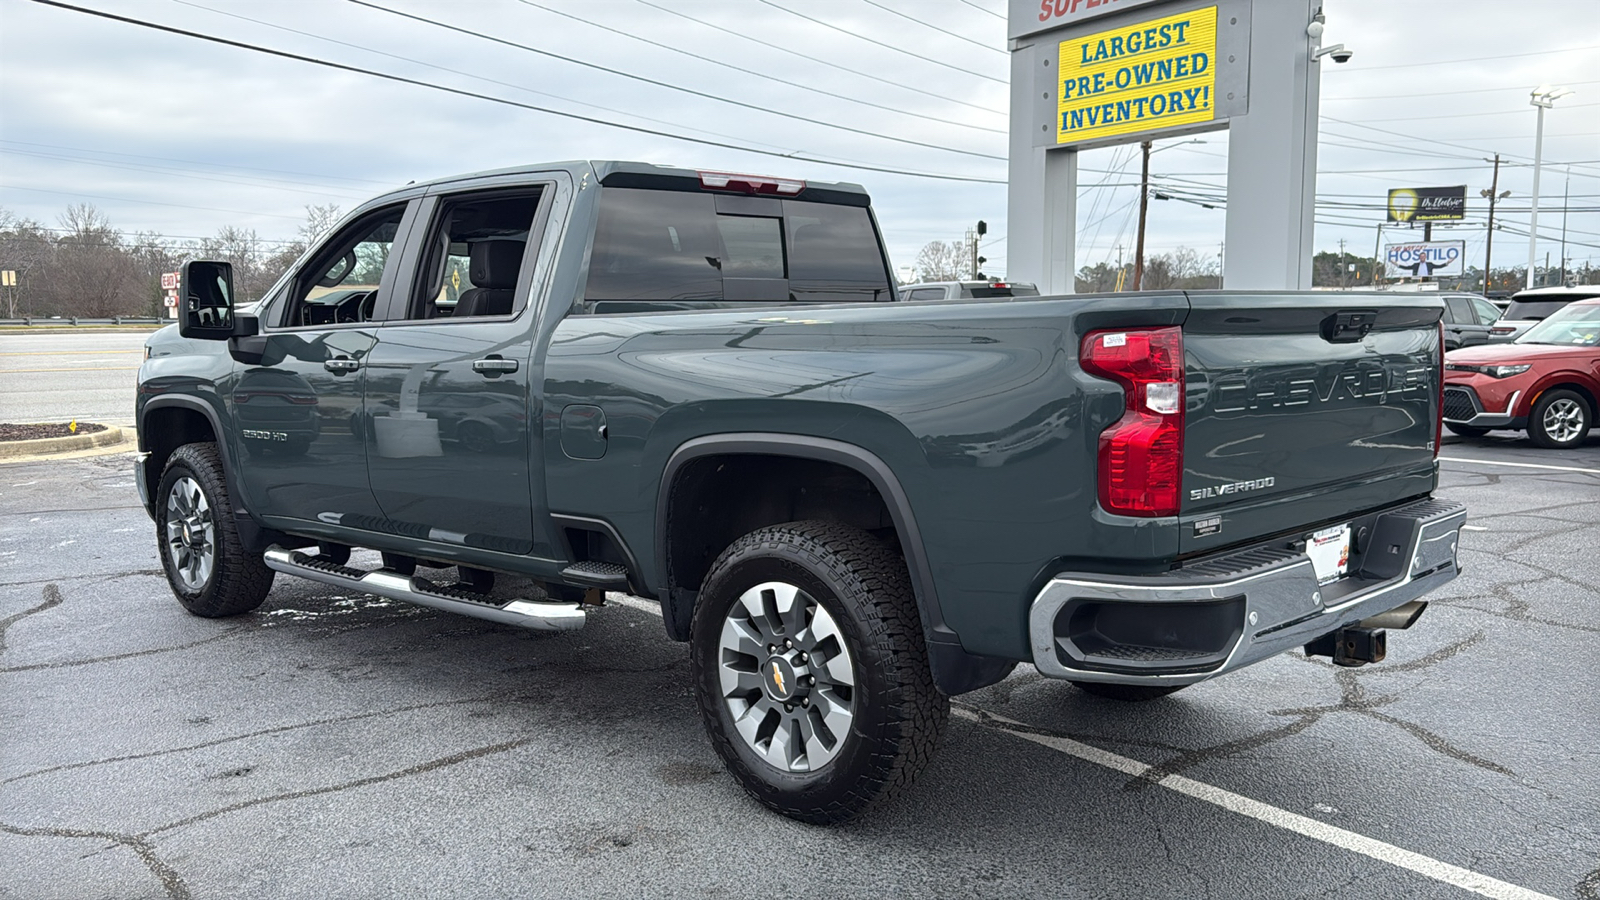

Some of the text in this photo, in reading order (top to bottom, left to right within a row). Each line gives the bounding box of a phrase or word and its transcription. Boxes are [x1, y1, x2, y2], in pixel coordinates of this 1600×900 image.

[1080, 20, 1190, 64] LARGEST
[1063, 52, 1209, 99] PRE-OWNED
[1061, 86, 1209, 131] INVENTORY!
[1388, 248, 1459, 262] HOSTILO
[1214, 365, 1433, 413] CHEVROLET
[243, 429, 288, 441] 2500 HD
[1190, 476, 1275, 501] SILVERADO
